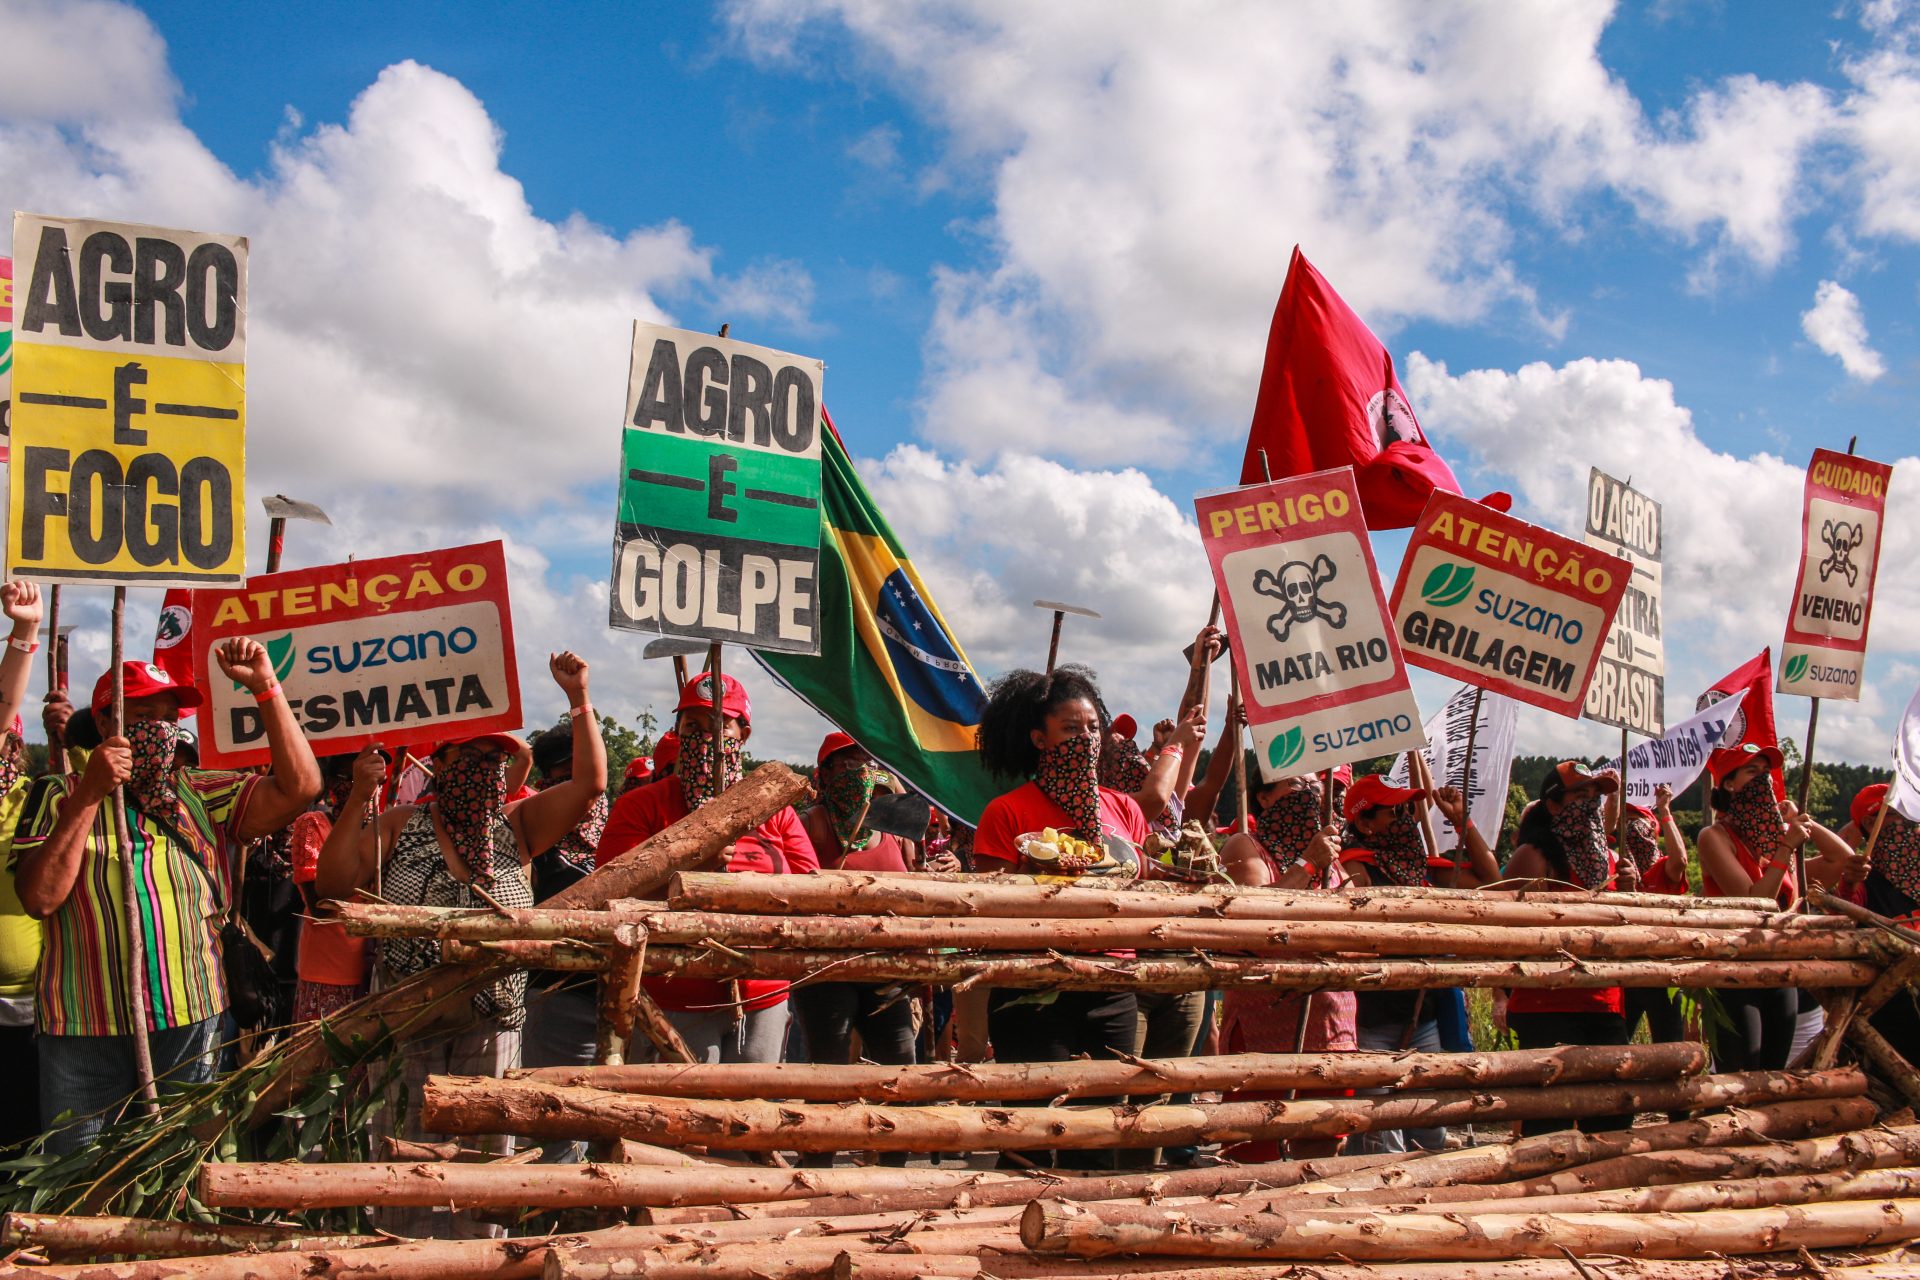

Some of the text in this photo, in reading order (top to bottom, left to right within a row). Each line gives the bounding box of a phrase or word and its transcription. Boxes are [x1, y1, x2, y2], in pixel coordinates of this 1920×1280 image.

[22, 226, 238, 351] AGRO
[113, 362, 148, 446] É
[633, 338, 815, 453] AGRO
[21, 446, 233, 569] FOGO
[1812, 460, 1883, 498] CUIDADO
[1209, 489, 1351, 539] PERIGO
[1590, 476, 1658, 555] O AGRO
[1427, 510, 1613, 596] ATENÇÃO
[210, 562, 488, 627] ATENÇÃO
[619, 538, 815, 643] GOLPE
[1475, 588, 1584, 645] suzano
[1802, 594, 1862, 626] VENENO
[307, 625, 478, 675] suzano
[1255, 637, 1388, 690] MATA RIO
[1402, 611, 1576, 694] GRILAGEM
[1617, 629, 1633, 662] DO
[1810, 665, 1858, 686] suzano
[1586, 660, 1661, 735] BRASIL
[1313, 714, 1411, 753] suzano
